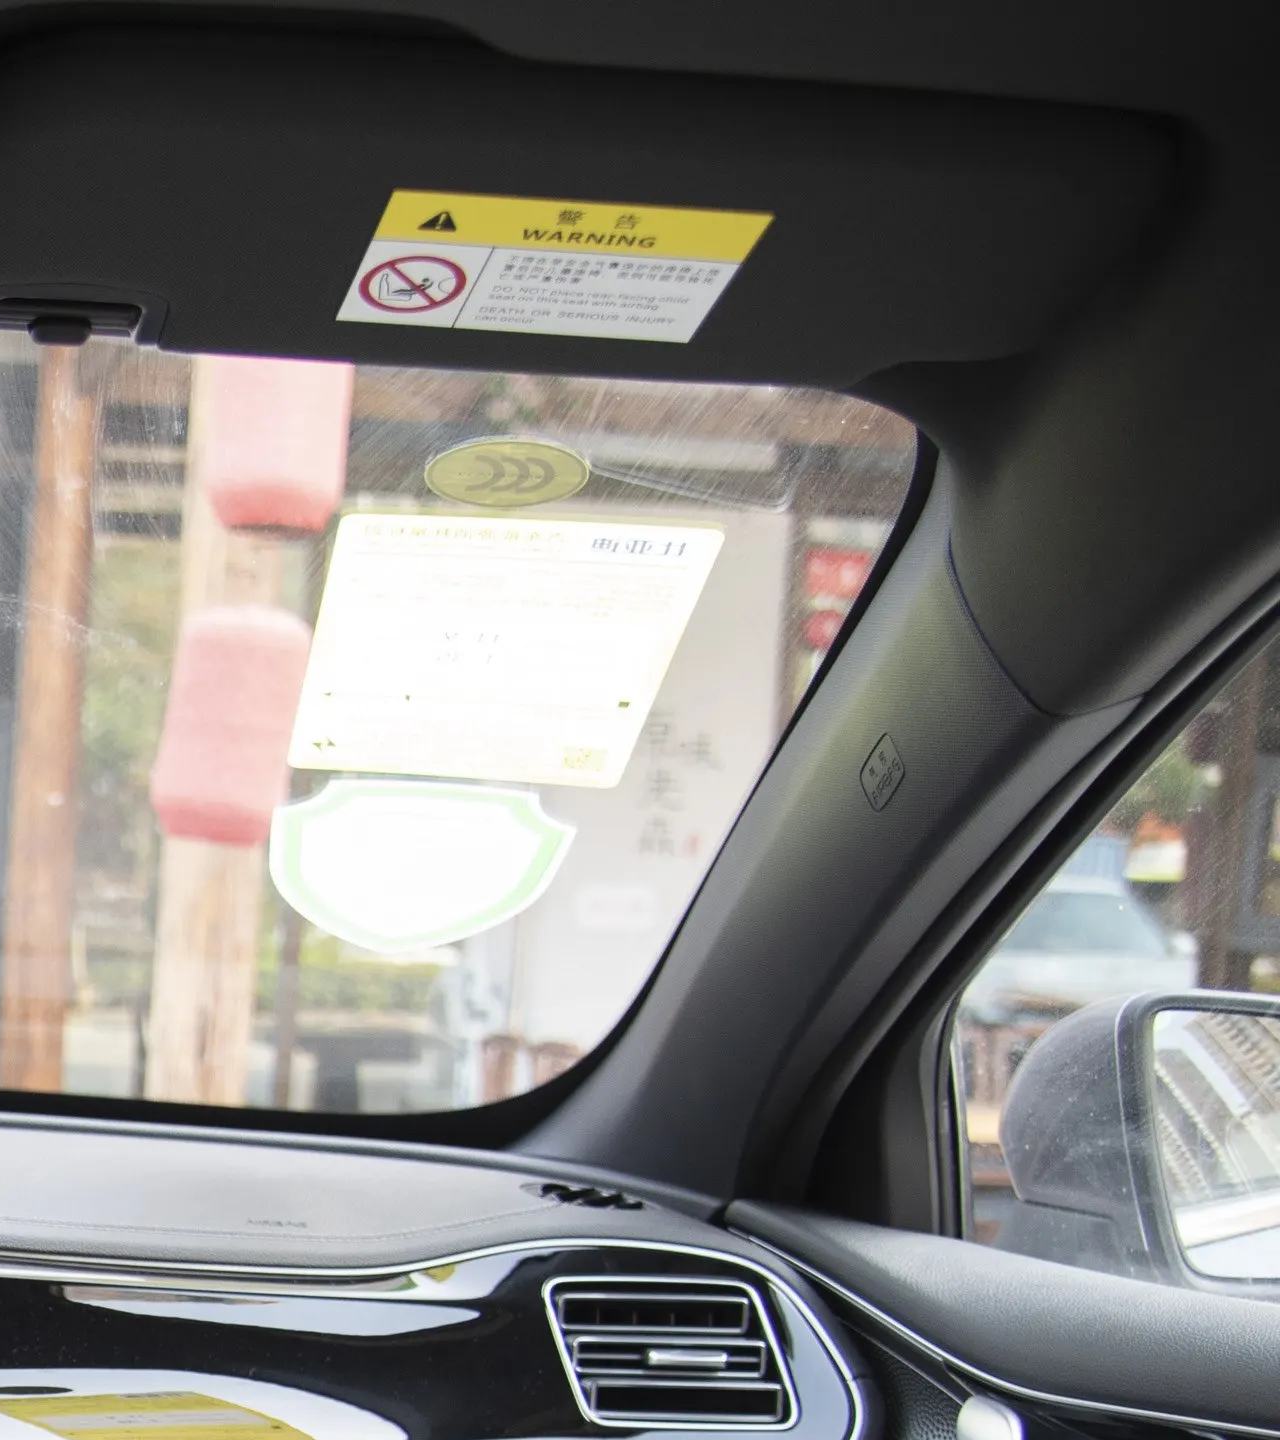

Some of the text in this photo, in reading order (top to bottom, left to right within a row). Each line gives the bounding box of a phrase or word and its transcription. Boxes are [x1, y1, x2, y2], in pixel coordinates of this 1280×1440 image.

[522, 229, 658, 249] WARNING
[488, 294, 515, 302] seat
[536, 295, 560, 304] this
[562, 297, 589, 306] seat
[591, 299, 617, 308] with
[620, 301, 660, 311] airbag
[492, 286, 512, 294] DO
[518, 287, 548, 296] NOT
[550, 288, 584, 299] place
[659, 295, 690, 305] child
[474, 315, 535, 325] can occur
[479, 306, 677, 324] DEATH OR SERIOUS INJURY
